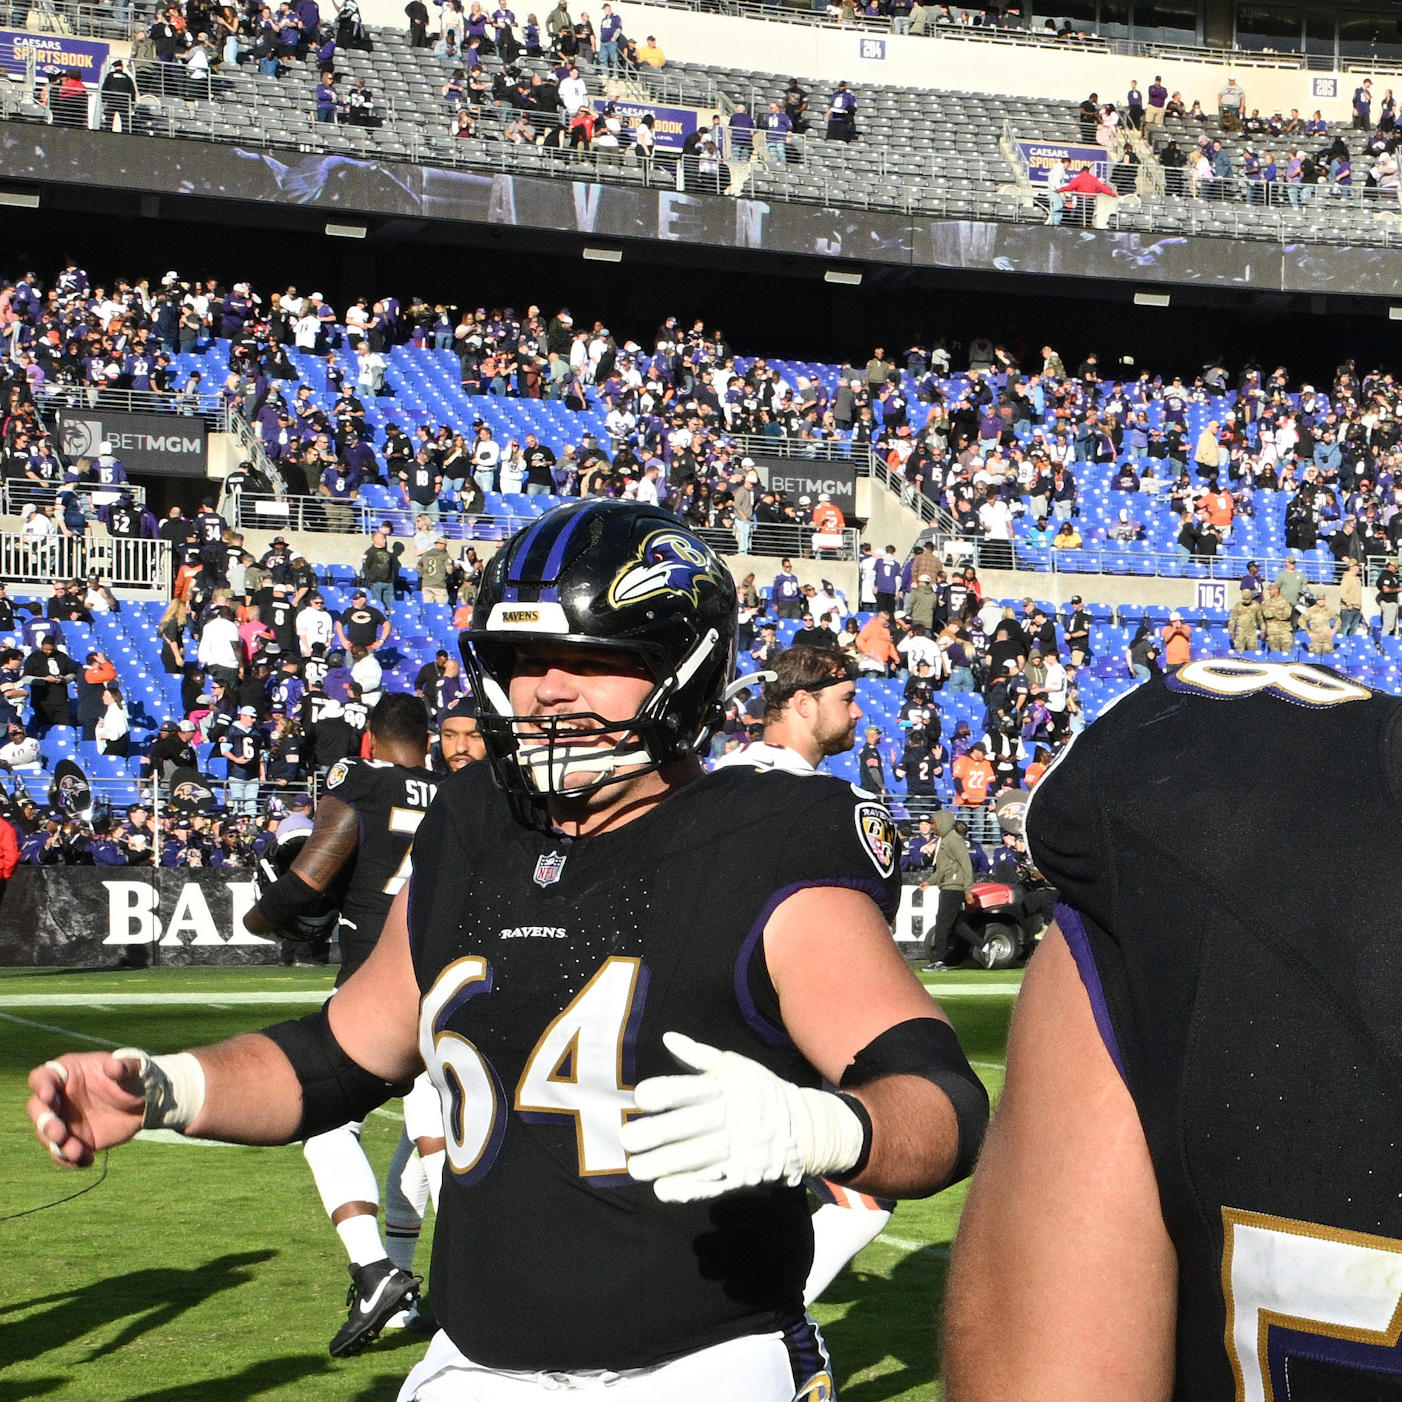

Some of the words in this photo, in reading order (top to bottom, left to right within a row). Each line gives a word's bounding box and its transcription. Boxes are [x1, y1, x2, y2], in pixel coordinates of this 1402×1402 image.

[13, 37, 61, 53] CAESARS
[13, 48, 94, 68] SPRTSBOOK
[107, 432, 200, 455] BETMGM
[773, 477, 852, 497] BETMGM
[427, 559, 437, 576] 8
[1200, 585, 1224, 609] 105
[502, 611, 540, 623] RAVENS
[243, 738, 254, 760] 6
[969, 771, 985, 788] 22
[538, 866, 556, 880] NFL
[500, 927, 567, 939] RAVENS
[419, 954, 650, 1178] 64
